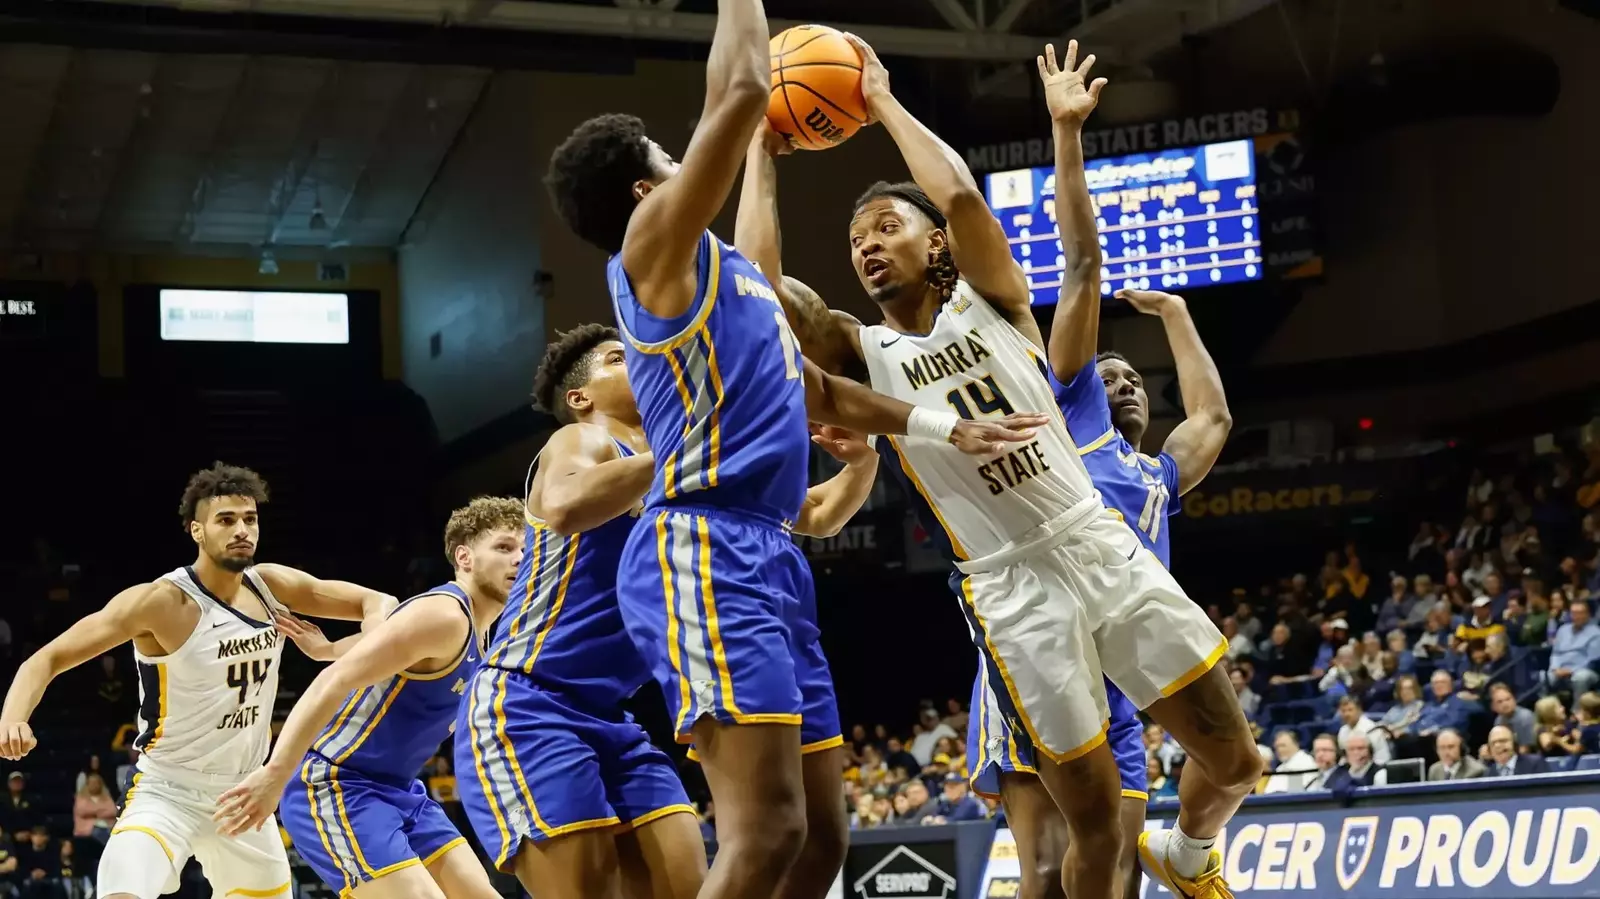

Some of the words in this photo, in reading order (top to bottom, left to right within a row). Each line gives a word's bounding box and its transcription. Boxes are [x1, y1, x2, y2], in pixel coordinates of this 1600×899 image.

[968, 139, 1056, 170] MURRA
[1082, 124, 1158, 157] STATE
[1163, 109, 1268, 144] RACERS
[946, 373, 1016, 420] 14
[977, 441, 1050, 496] STATE
[226, 658, 273, 705] 44
[216, 705, 260, 730] STATE
[1378, 806, 1600, 889] PROUD
